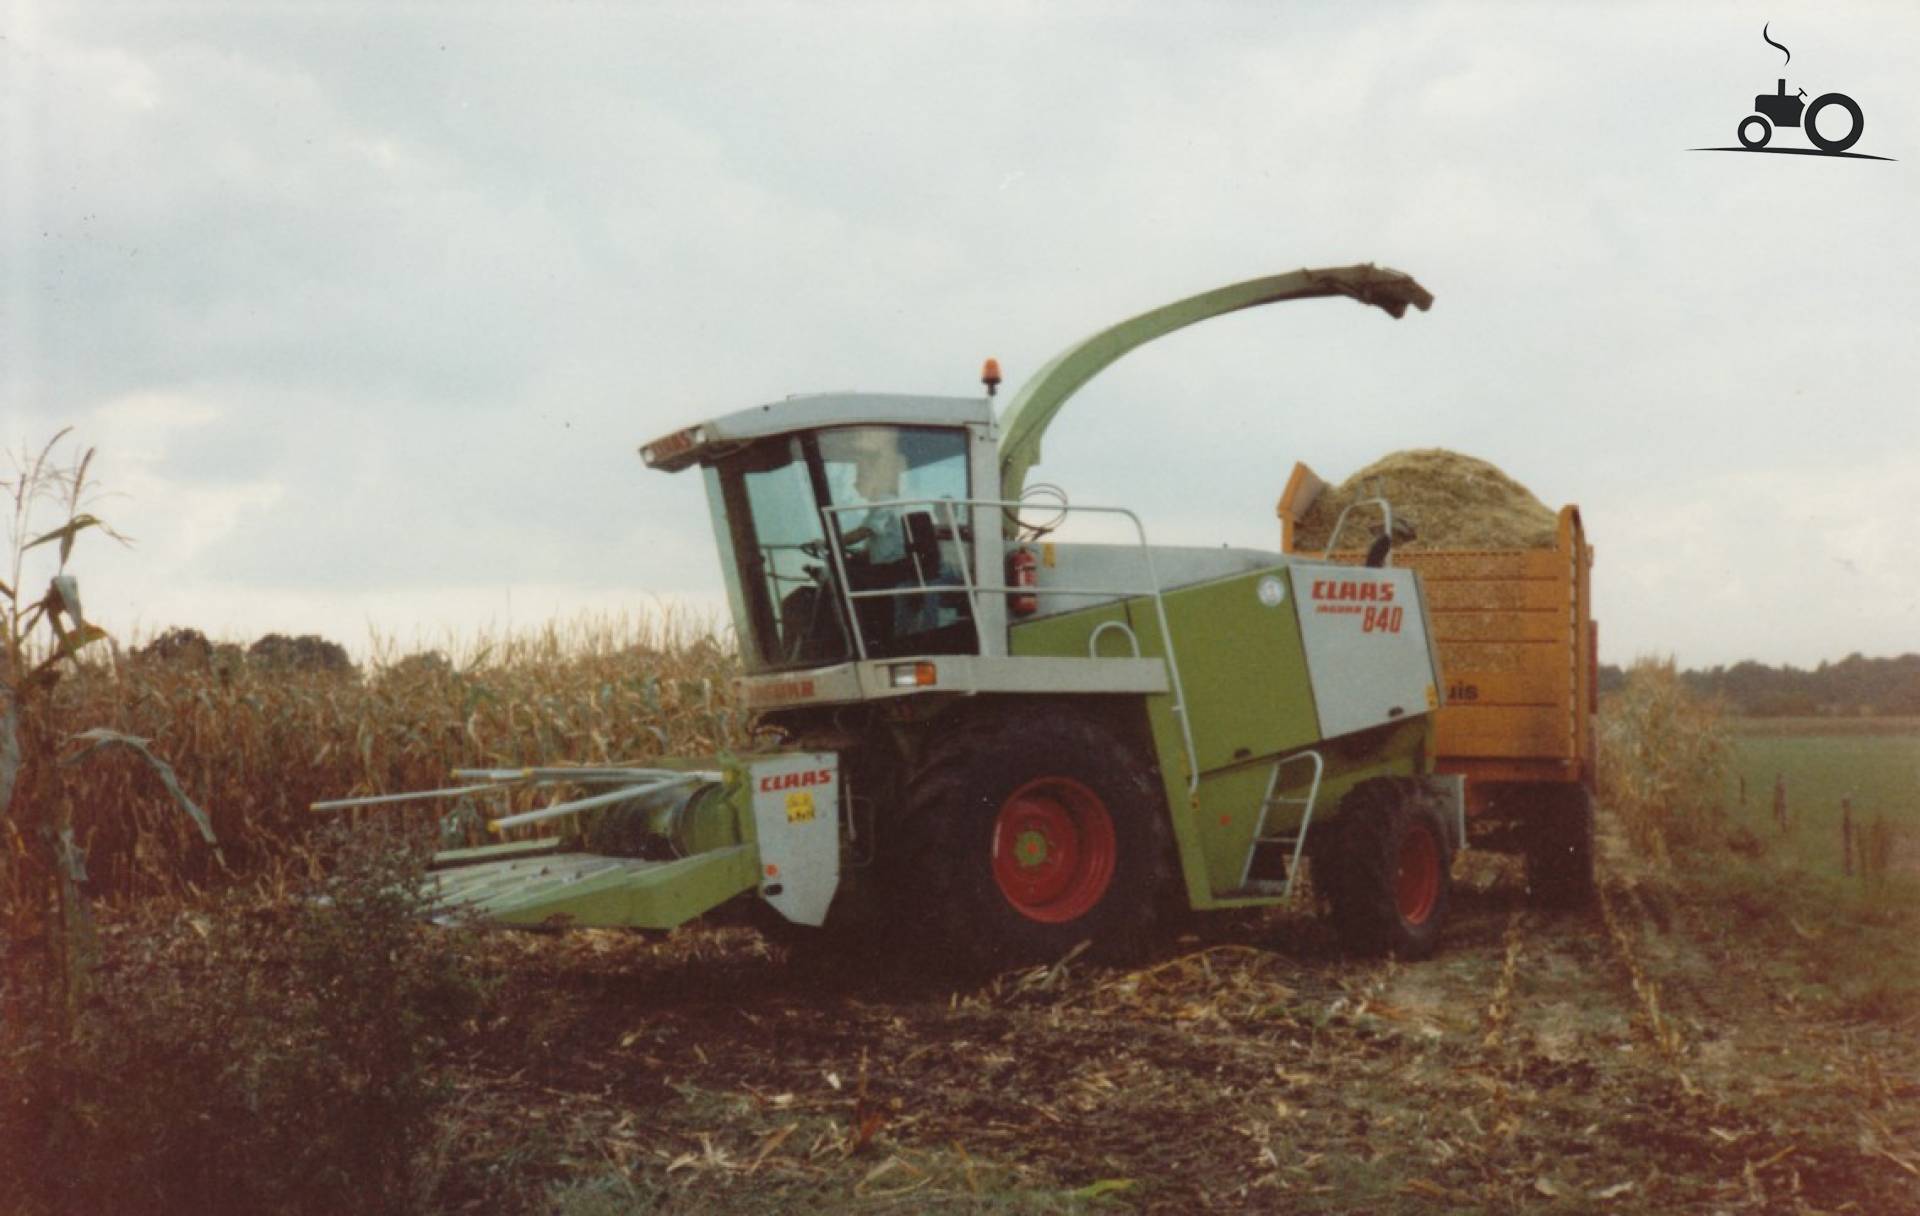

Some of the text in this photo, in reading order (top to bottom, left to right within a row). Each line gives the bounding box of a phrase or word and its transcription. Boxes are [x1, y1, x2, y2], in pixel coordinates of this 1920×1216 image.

[1312, 580, 1394, 602] CLAAS
[1363, 606, 1403, 633] 840
[760, 769, 832, 793] CLAAS
